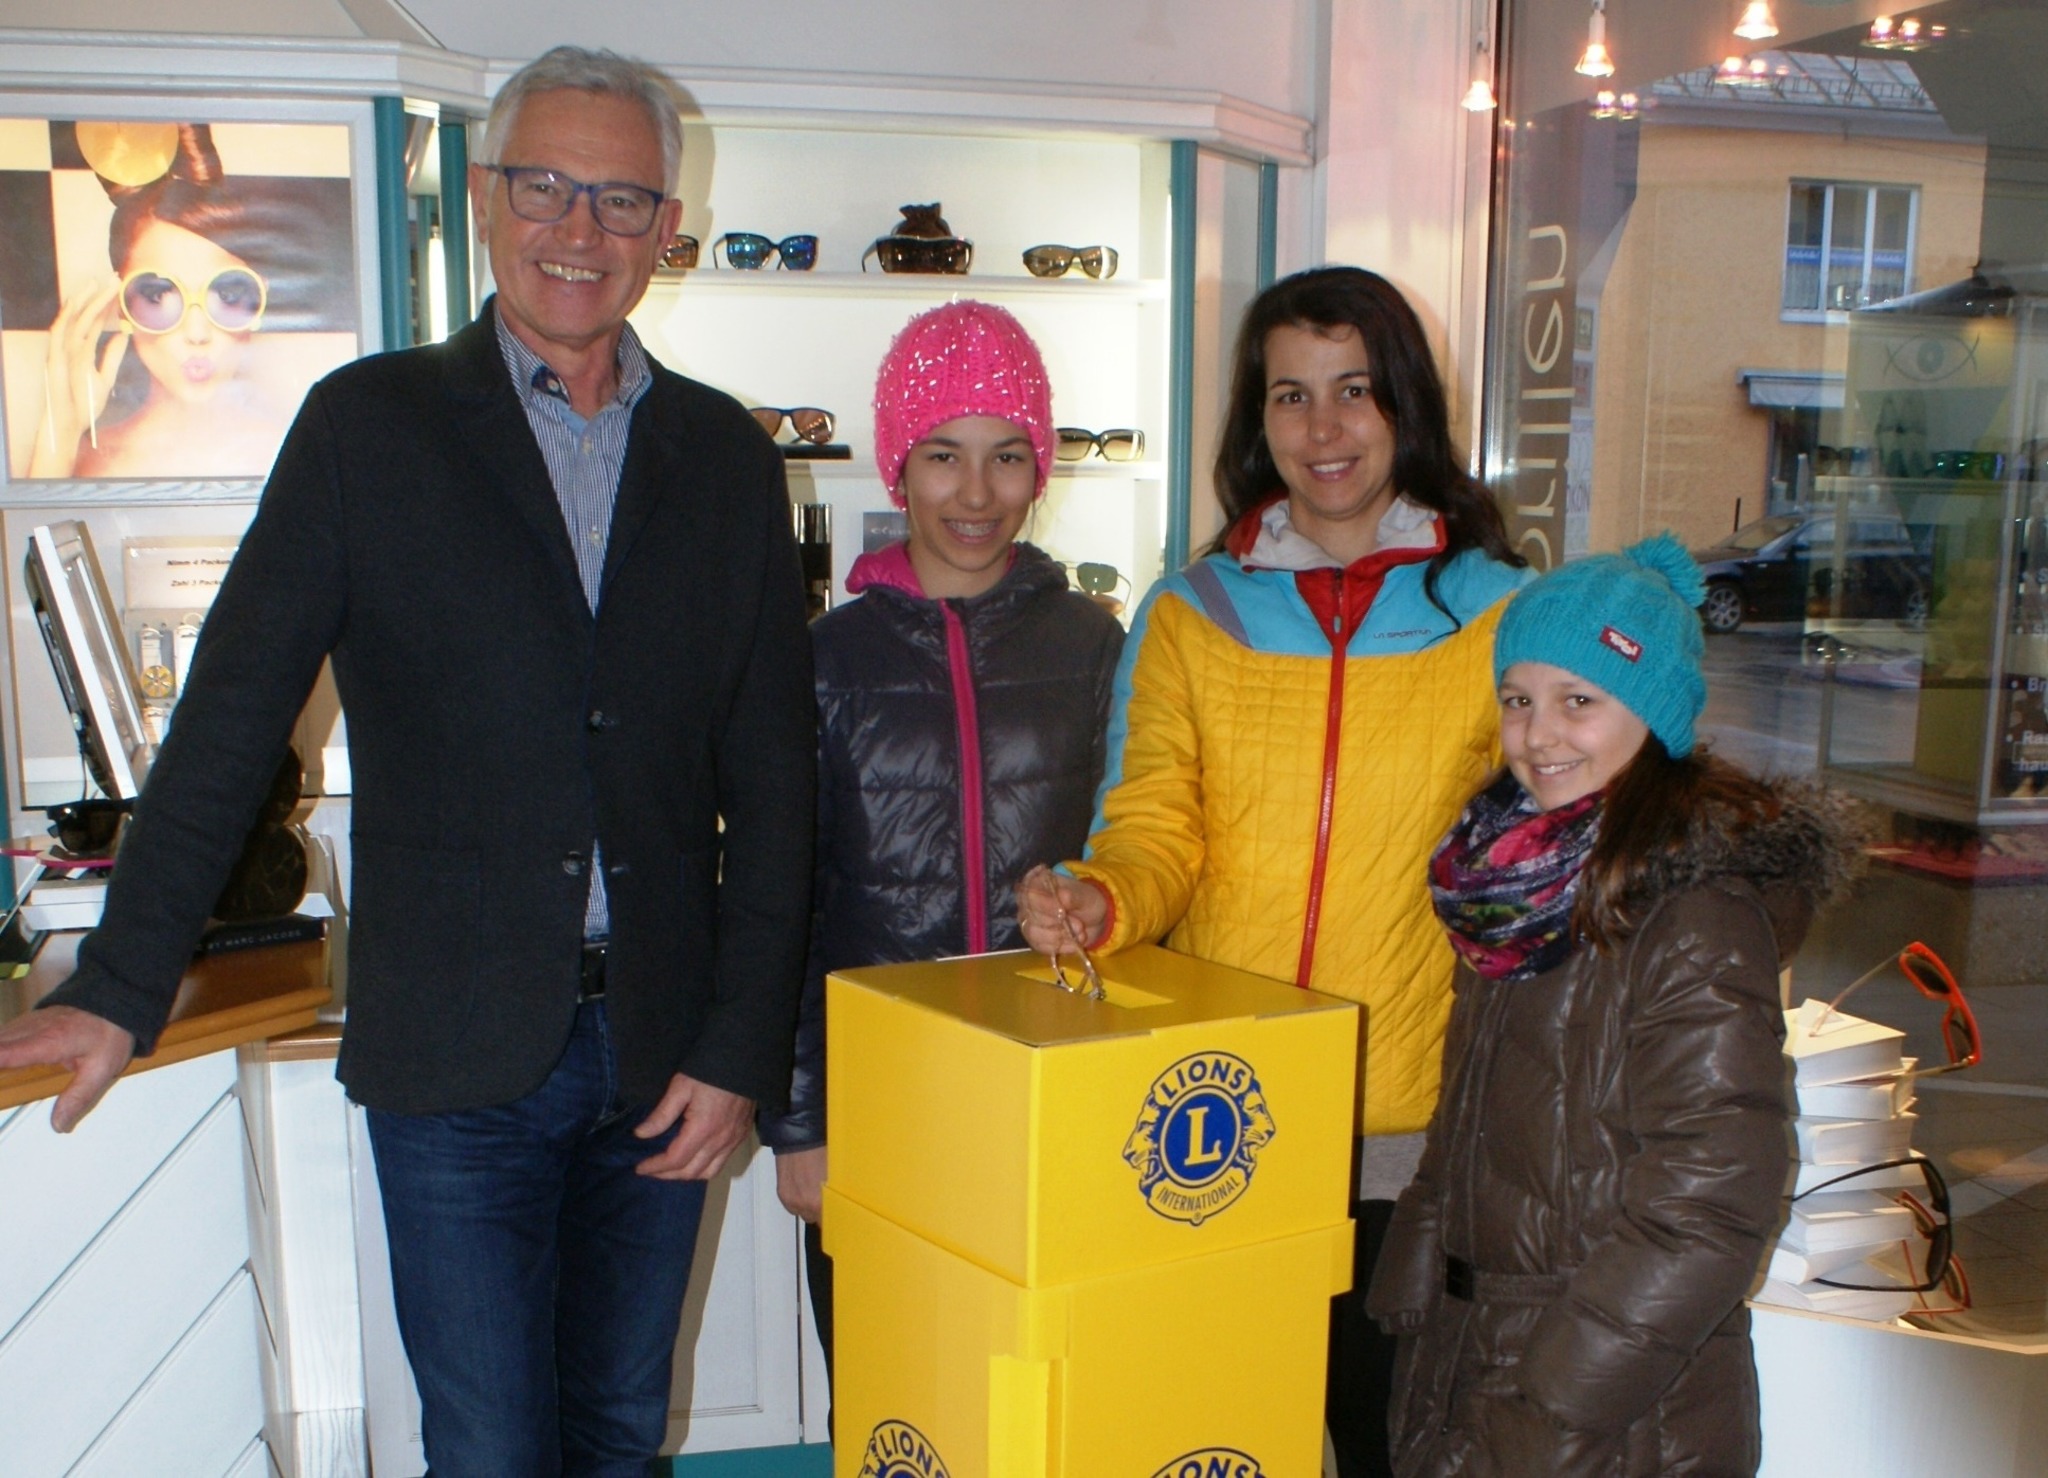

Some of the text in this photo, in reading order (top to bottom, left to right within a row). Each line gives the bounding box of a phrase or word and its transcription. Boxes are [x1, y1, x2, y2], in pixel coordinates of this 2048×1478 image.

[225, 936, 255, 946] MARC
[259, 929, 302, 940] JACOBS
[1160, 1058, 1246, 1100] LIONS
[1184, 1106, 1222, 1166] L
[1156, 1176, 1240, 1212] INTERNATIONAL
